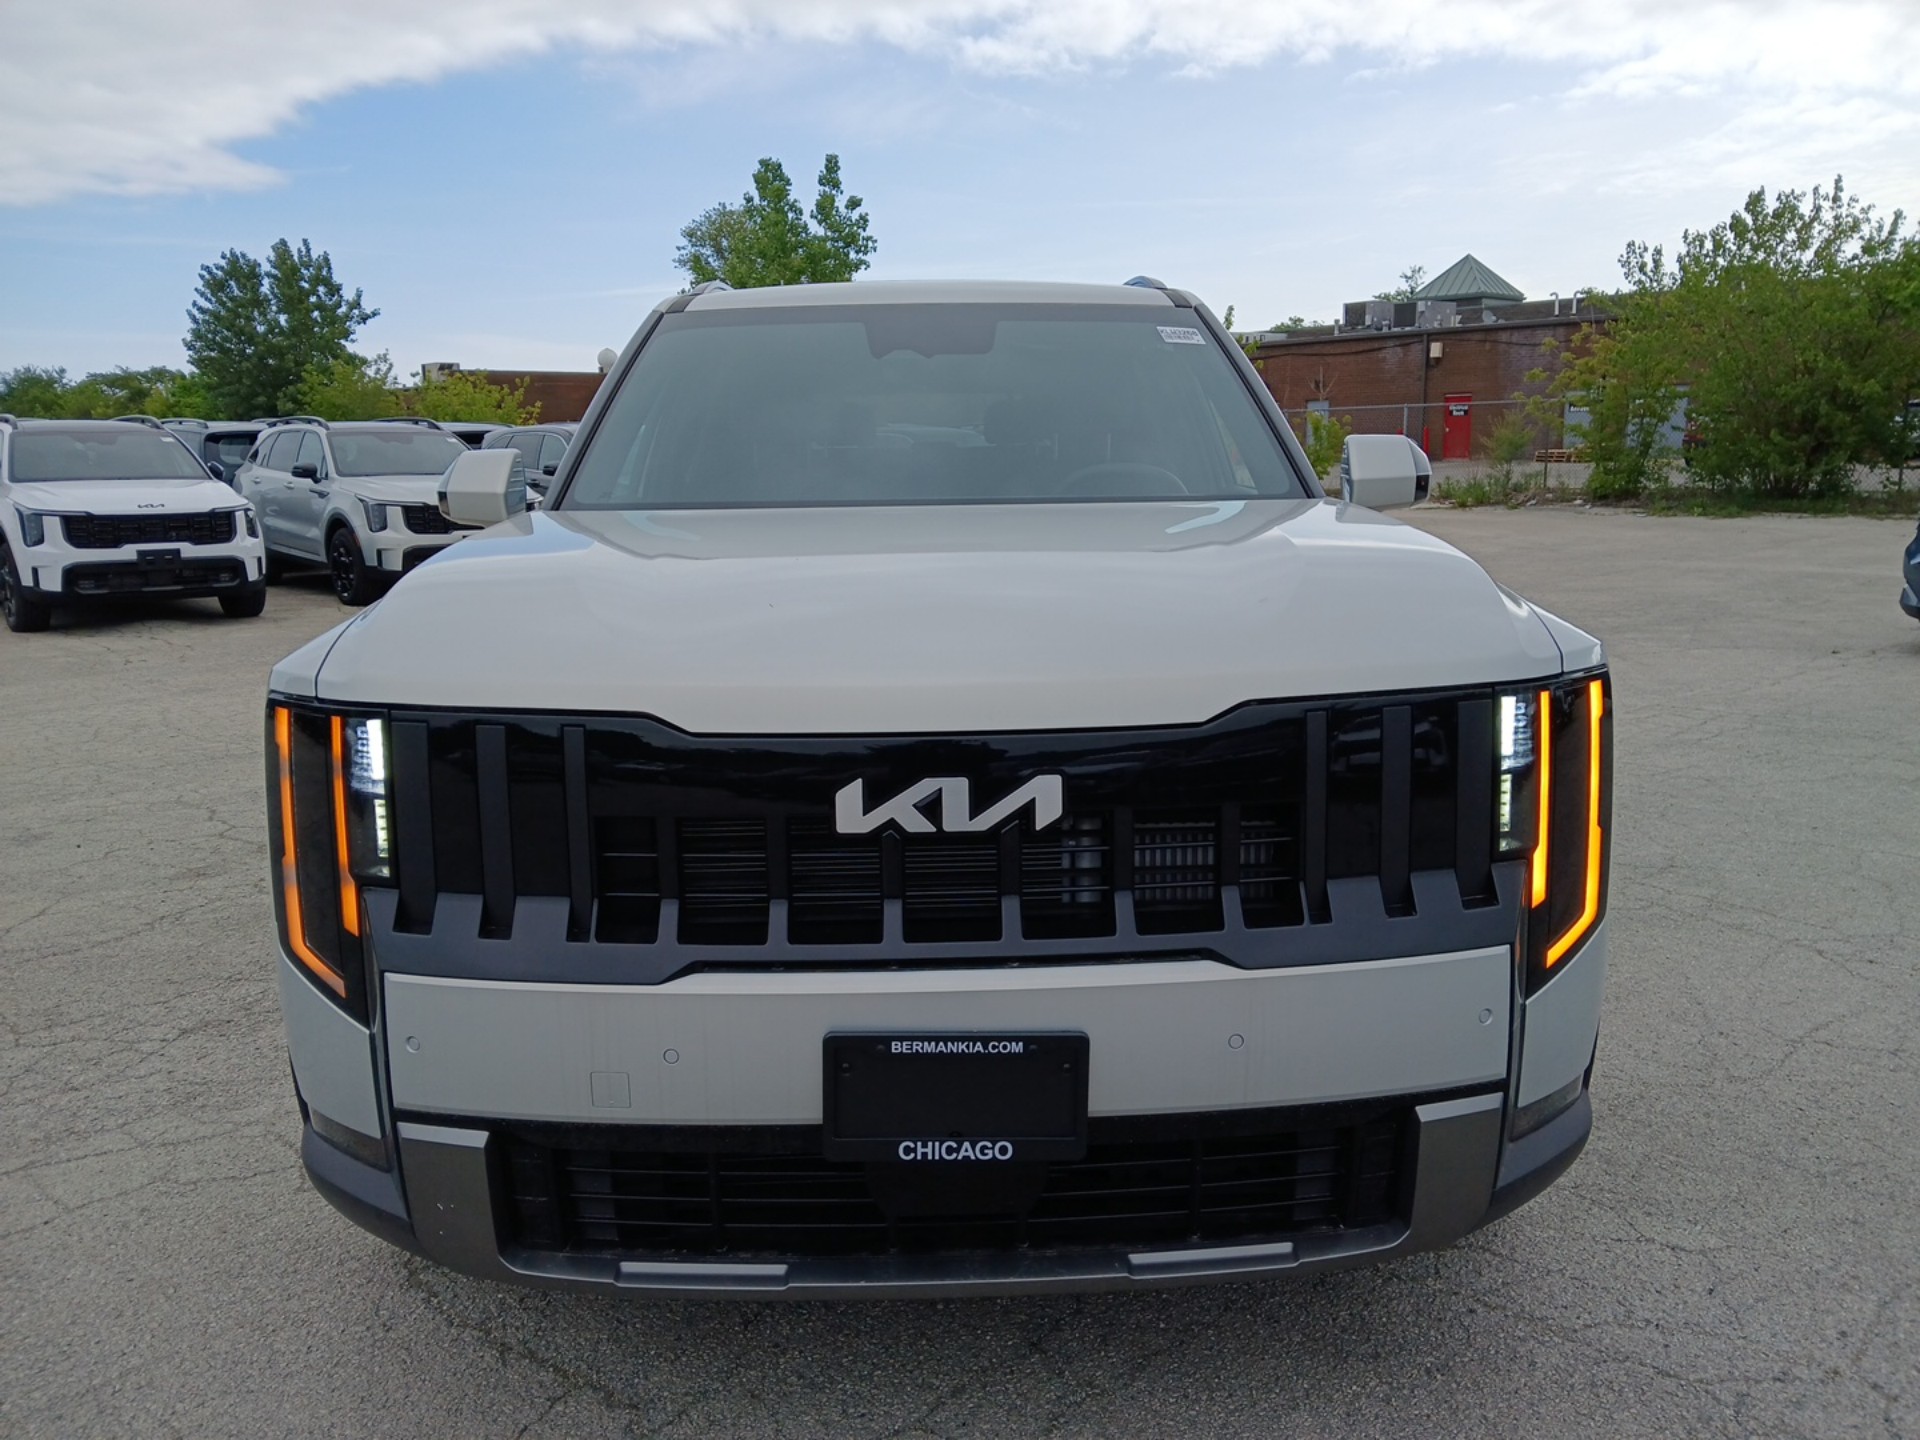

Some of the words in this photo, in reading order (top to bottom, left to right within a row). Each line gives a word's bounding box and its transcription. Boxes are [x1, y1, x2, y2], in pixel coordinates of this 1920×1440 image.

[835, 774, 1063, 833] KIA
[890, 1041, 1024, 1053] BERMANKIA.COM
[898, 1141, 1013, 1160] CHICAGO
